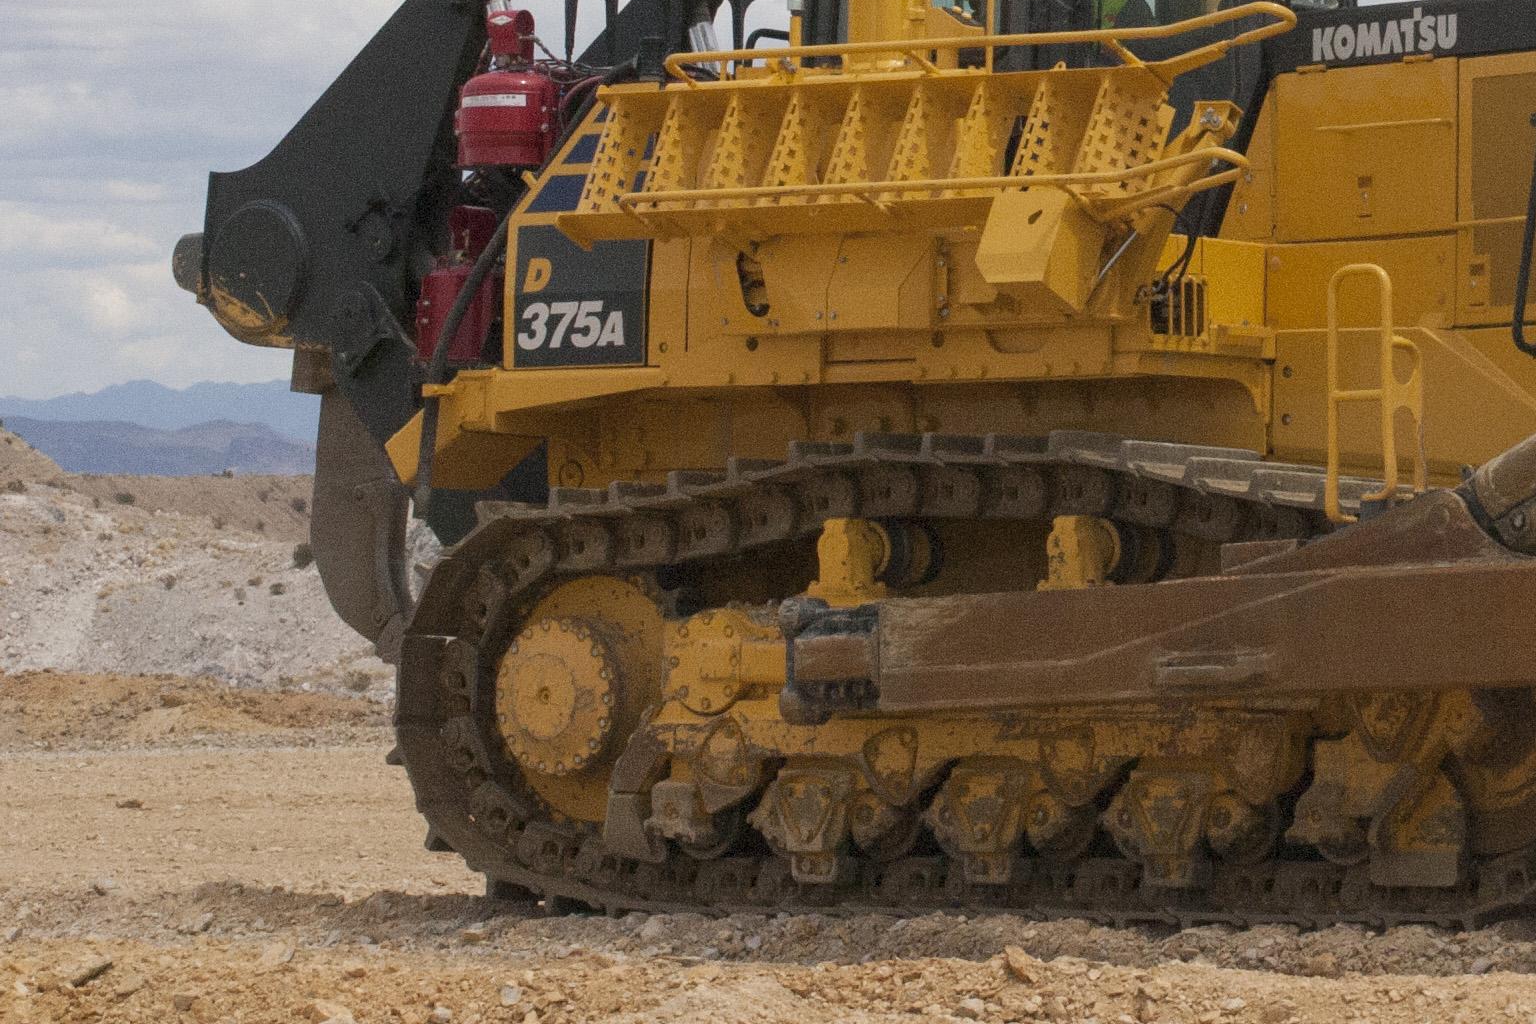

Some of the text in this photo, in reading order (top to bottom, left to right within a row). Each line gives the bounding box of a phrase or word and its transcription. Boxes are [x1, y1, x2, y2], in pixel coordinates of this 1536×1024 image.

[1312, 7, 1458, 62] KOMATSU
[523, 257, 552, 293] D
[517, 300, 625, 350] 375A
